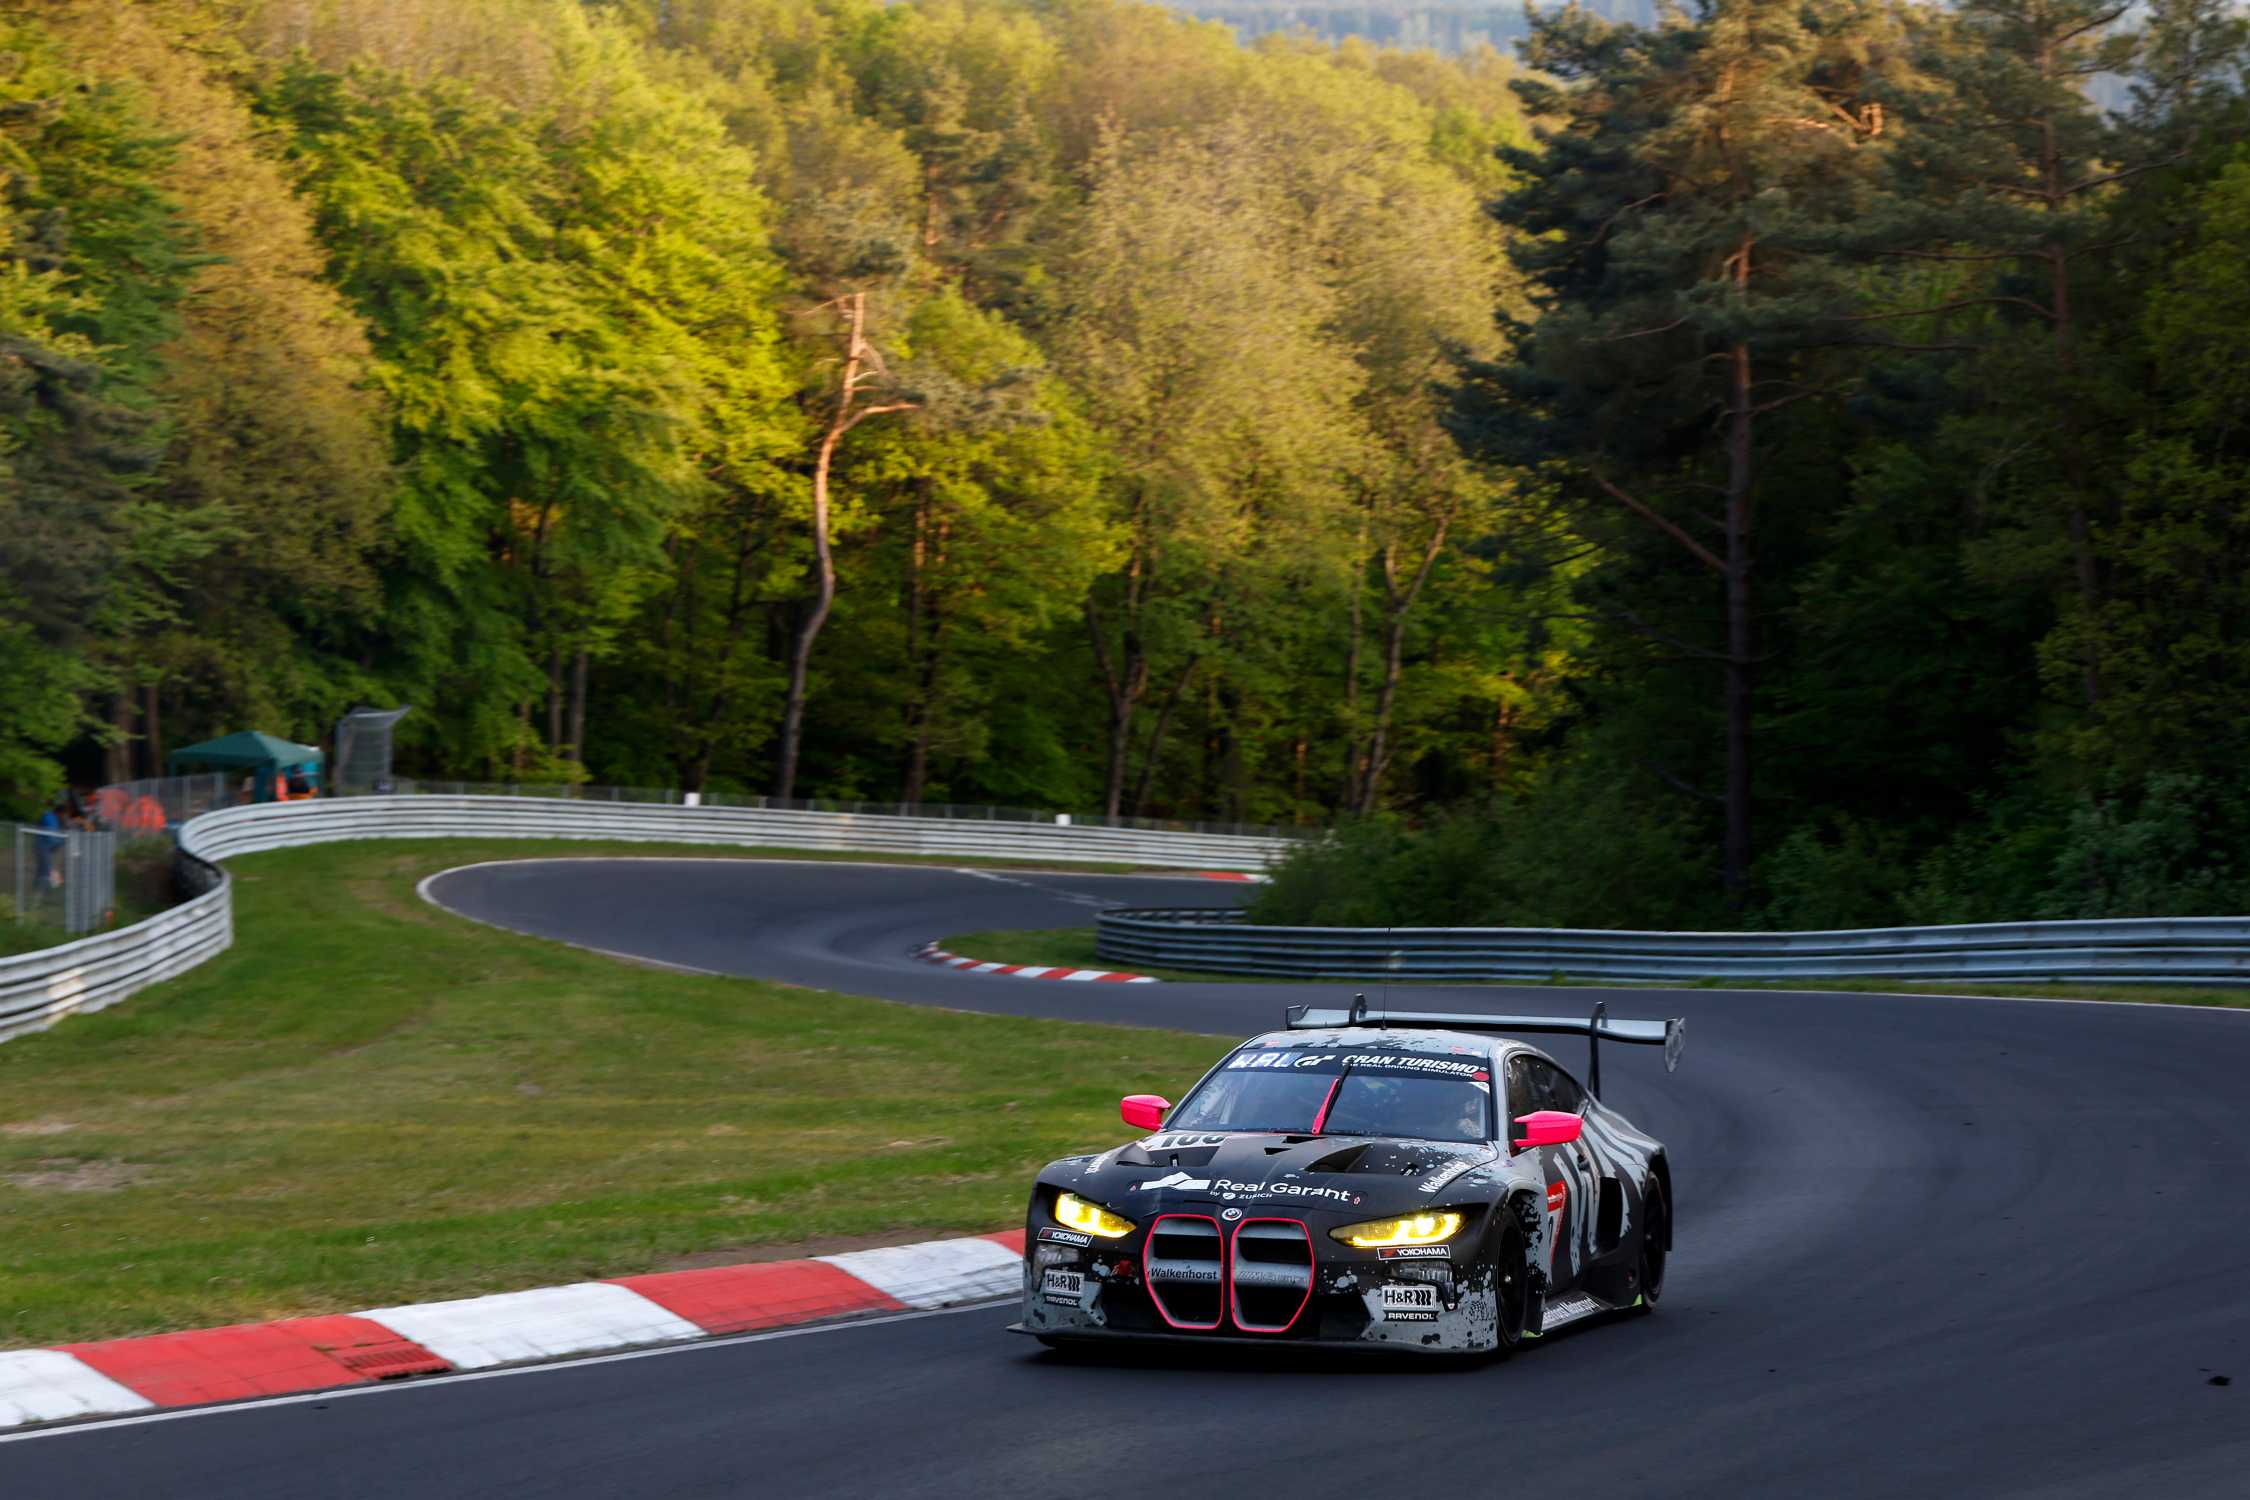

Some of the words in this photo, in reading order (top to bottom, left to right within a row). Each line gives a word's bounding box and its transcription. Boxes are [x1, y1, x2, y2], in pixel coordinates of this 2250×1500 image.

[1342, 1054, 1394, 1065] GRAN
[1398, 1057, 1478, 1073] TURISMO
[1215, 1179, 1266, 1192] Real
[1270, 1182, 1350, 1202] Garant
[1051, 1231, 1088, 1244] YOKOHAMA
[1397, 1247, 1447, 1256] YOKOHAMA
[1151, 1267, 1217, 1280] Walkenhorst
[1047, 1273, 1068, 1289] H&R
[1384, 1290, 1414, 1305] H&R
[1388, 1312, 1435, 1320] RAVENOL
